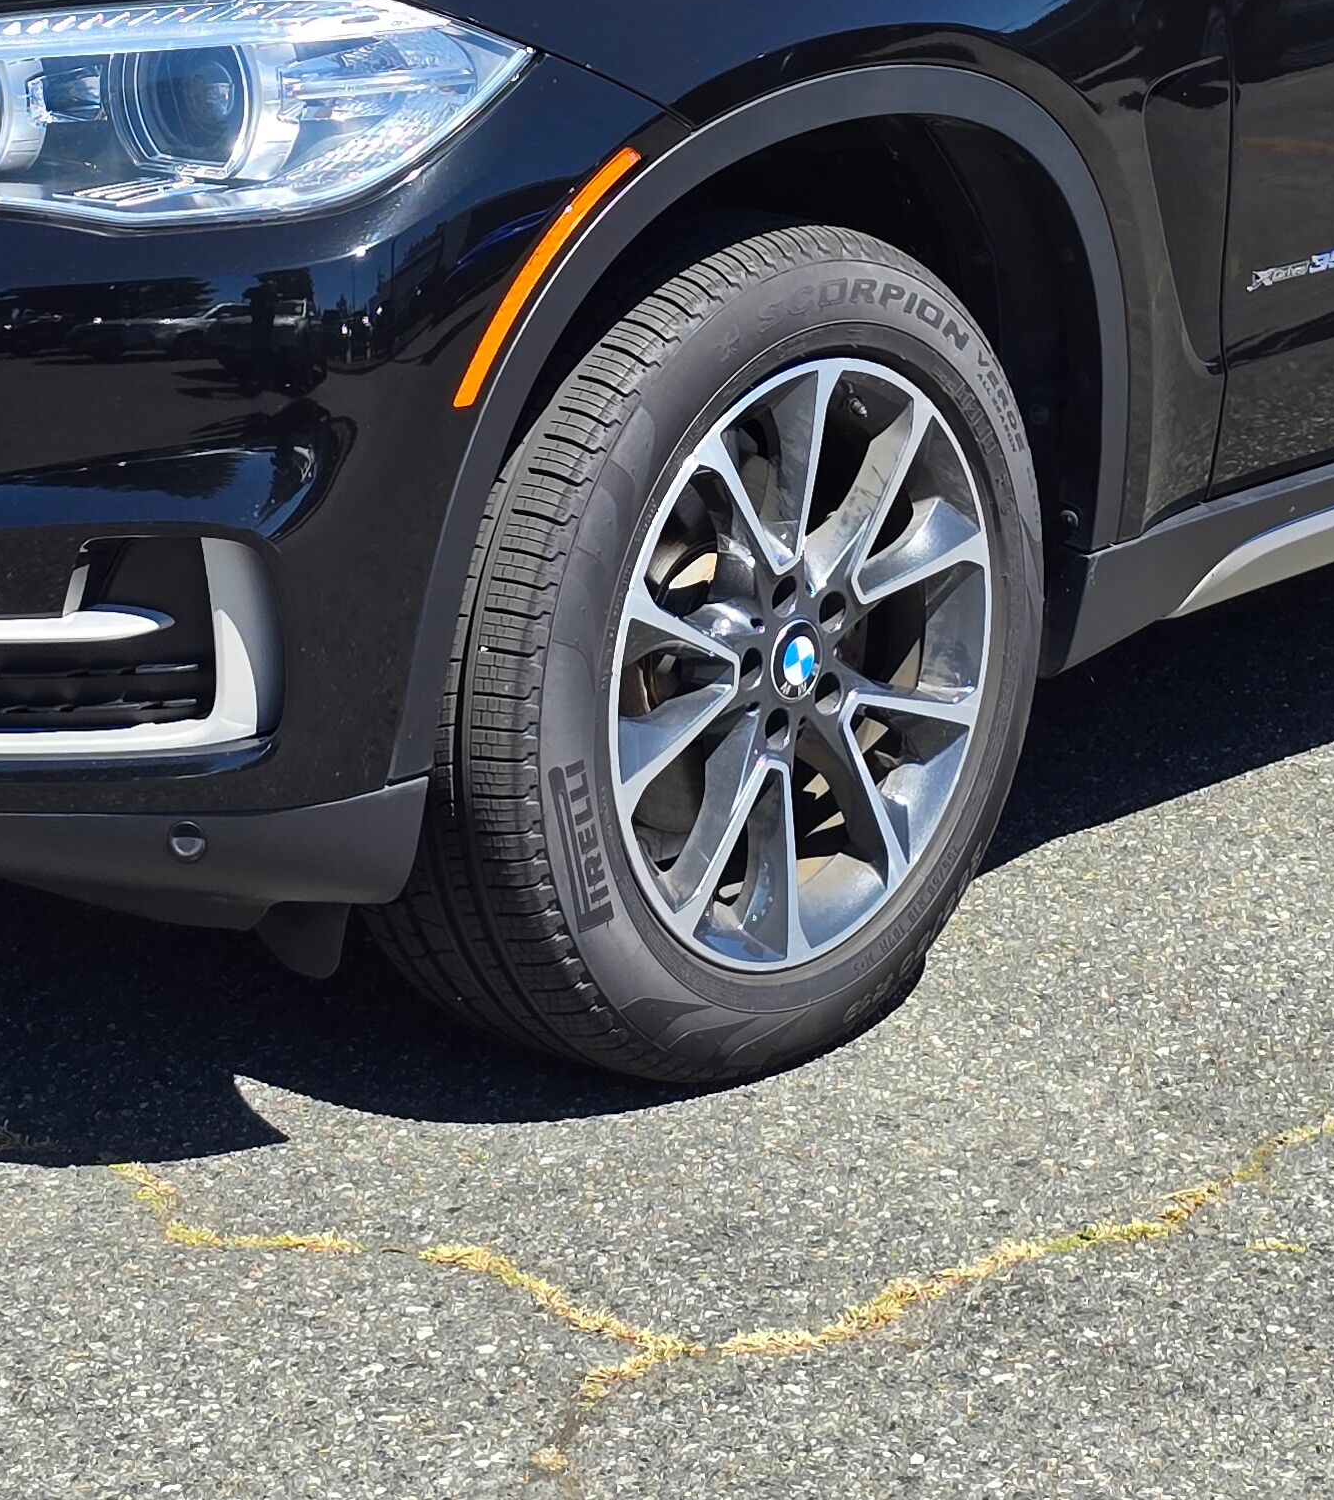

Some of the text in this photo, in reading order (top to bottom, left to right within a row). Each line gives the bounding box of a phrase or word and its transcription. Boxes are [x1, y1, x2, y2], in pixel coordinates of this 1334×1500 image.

[758, 277, 970, 352] SCORPION
[978, 349, 1025, 452] VERDE
[548, 759, 615, 934] PIRELLI
